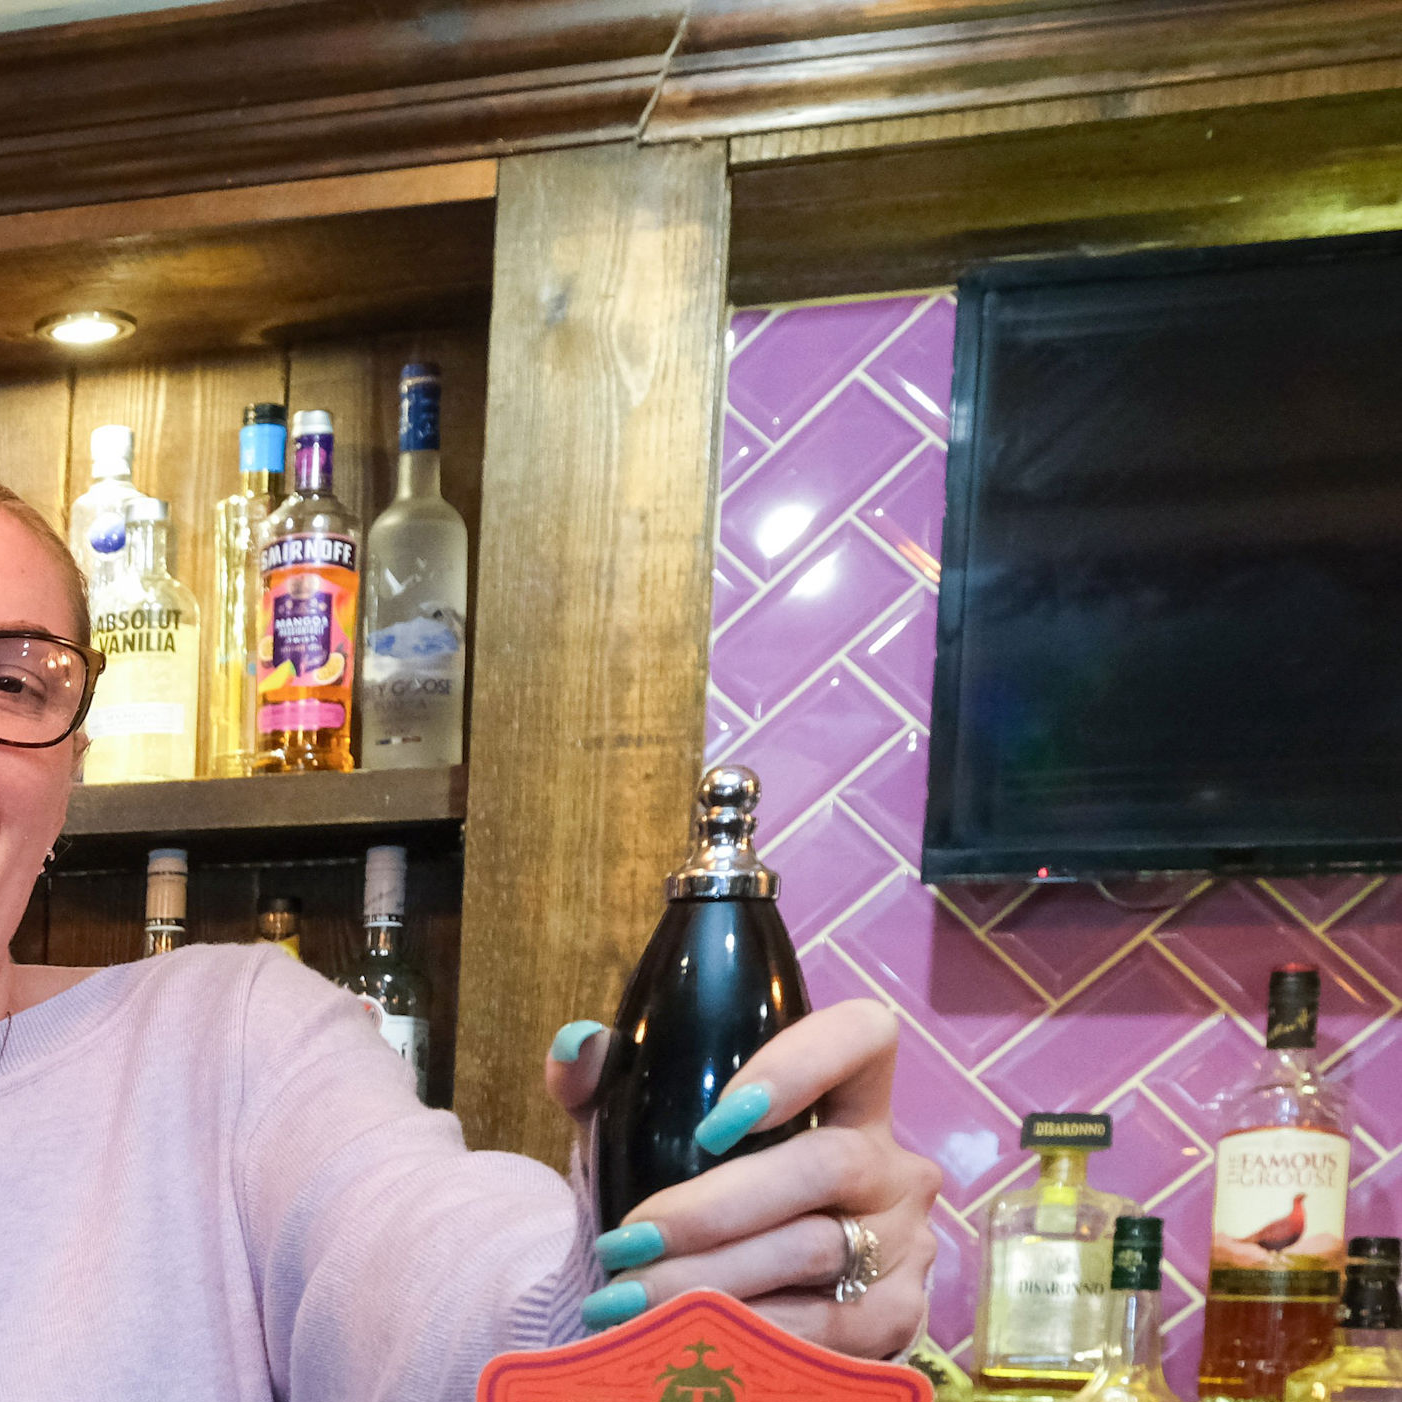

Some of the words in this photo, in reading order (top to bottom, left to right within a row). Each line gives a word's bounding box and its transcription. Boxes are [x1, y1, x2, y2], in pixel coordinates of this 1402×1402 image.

[96, 608, 182, 635] ABSOLUT
[99, 632, 176, 655] VANILIA
[1034, 1121, 1106, 1137] DISARONNO
[1241, 1151, 1338, 1170] FAMOUS
[1240, 1169, 1334, 1188] GROUSE
[1018, 1279, 1105, 1296] DISARONNO
